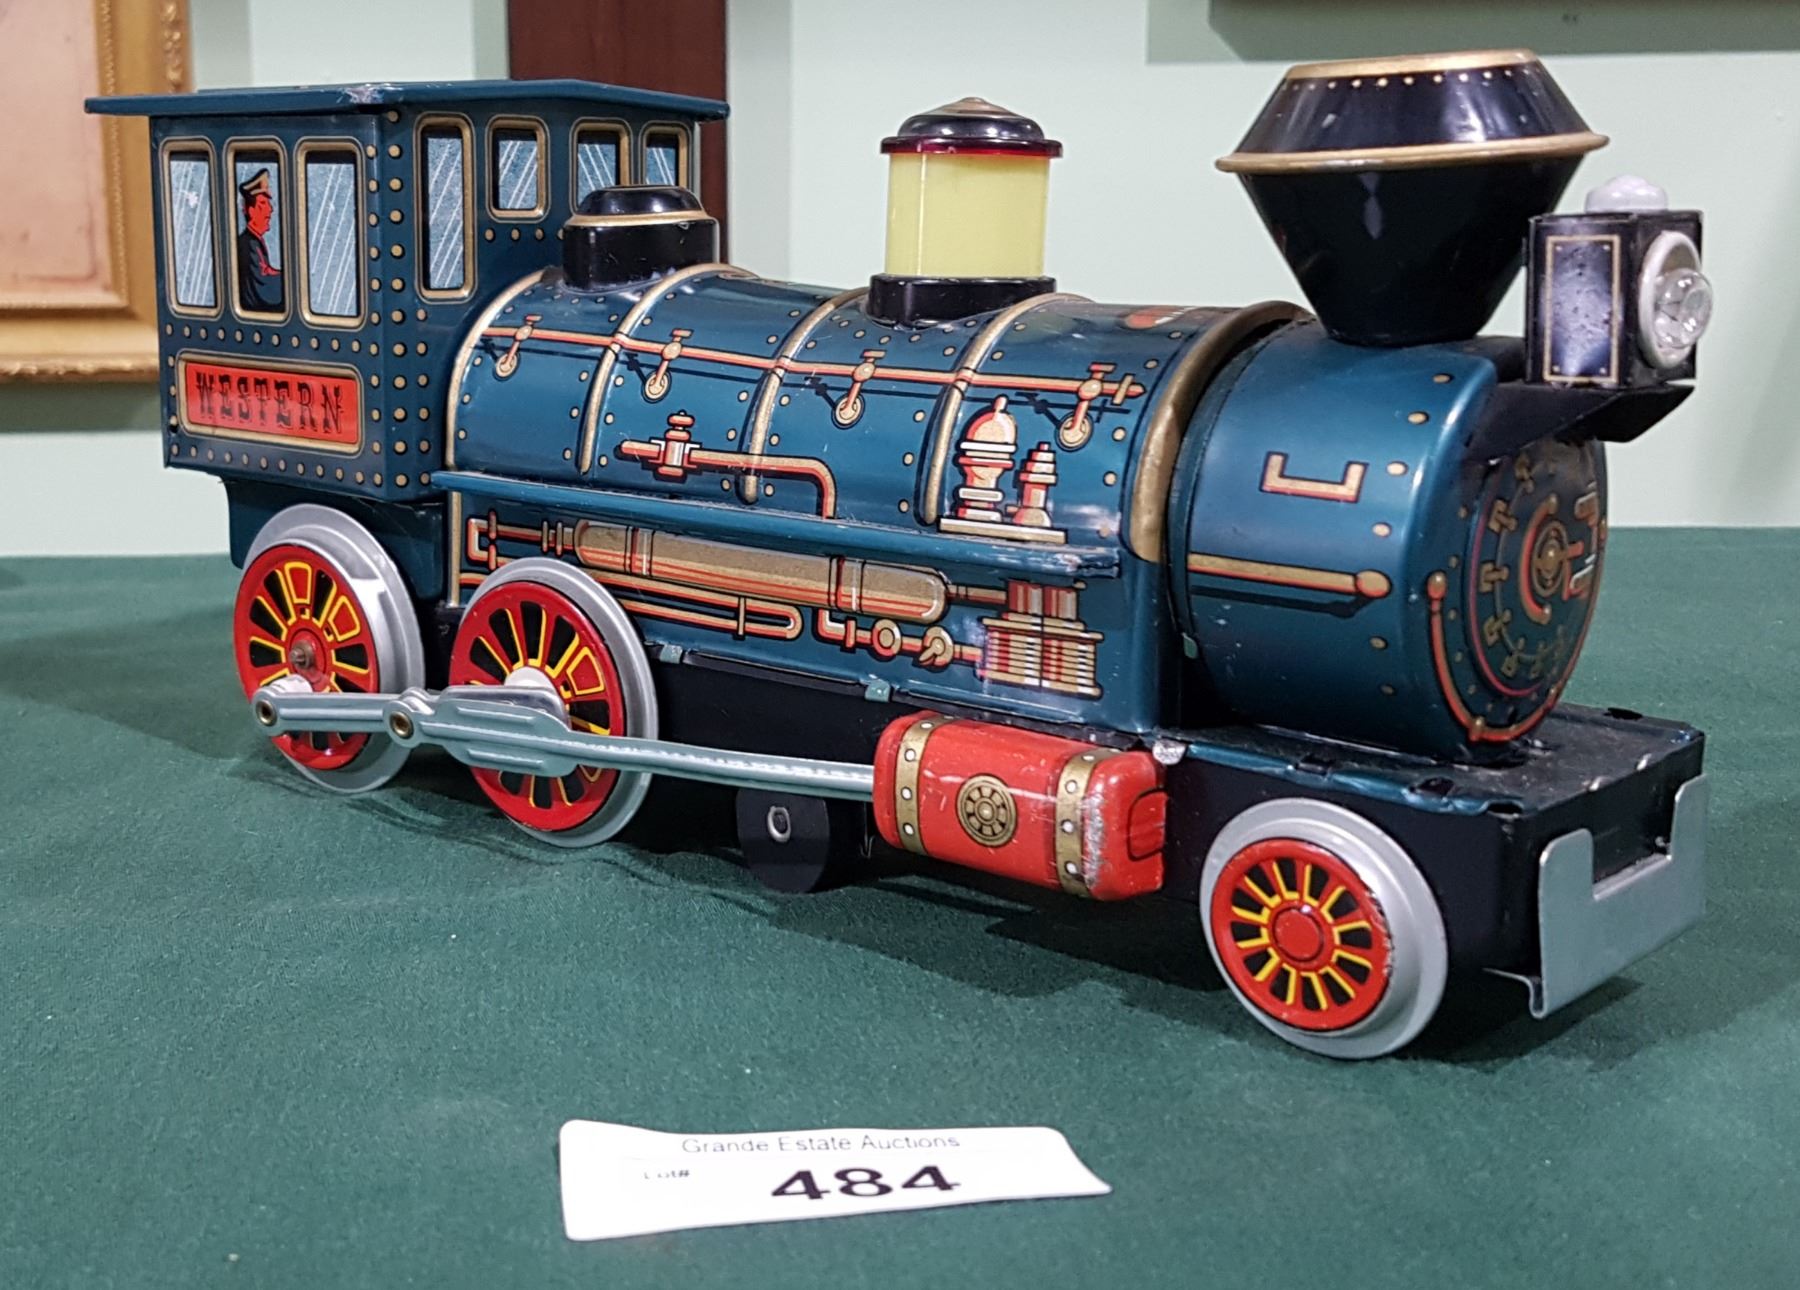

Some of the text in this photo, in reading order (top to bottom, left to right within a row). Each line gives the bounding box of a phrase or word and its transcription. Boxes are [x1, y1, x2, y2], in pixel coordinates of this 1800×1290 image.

[195, 371, 345, 434] WESTERN
[681, 1134, 961, 1153] Grande Estate Auctions
[770, 1165, 962, 1200] 484
